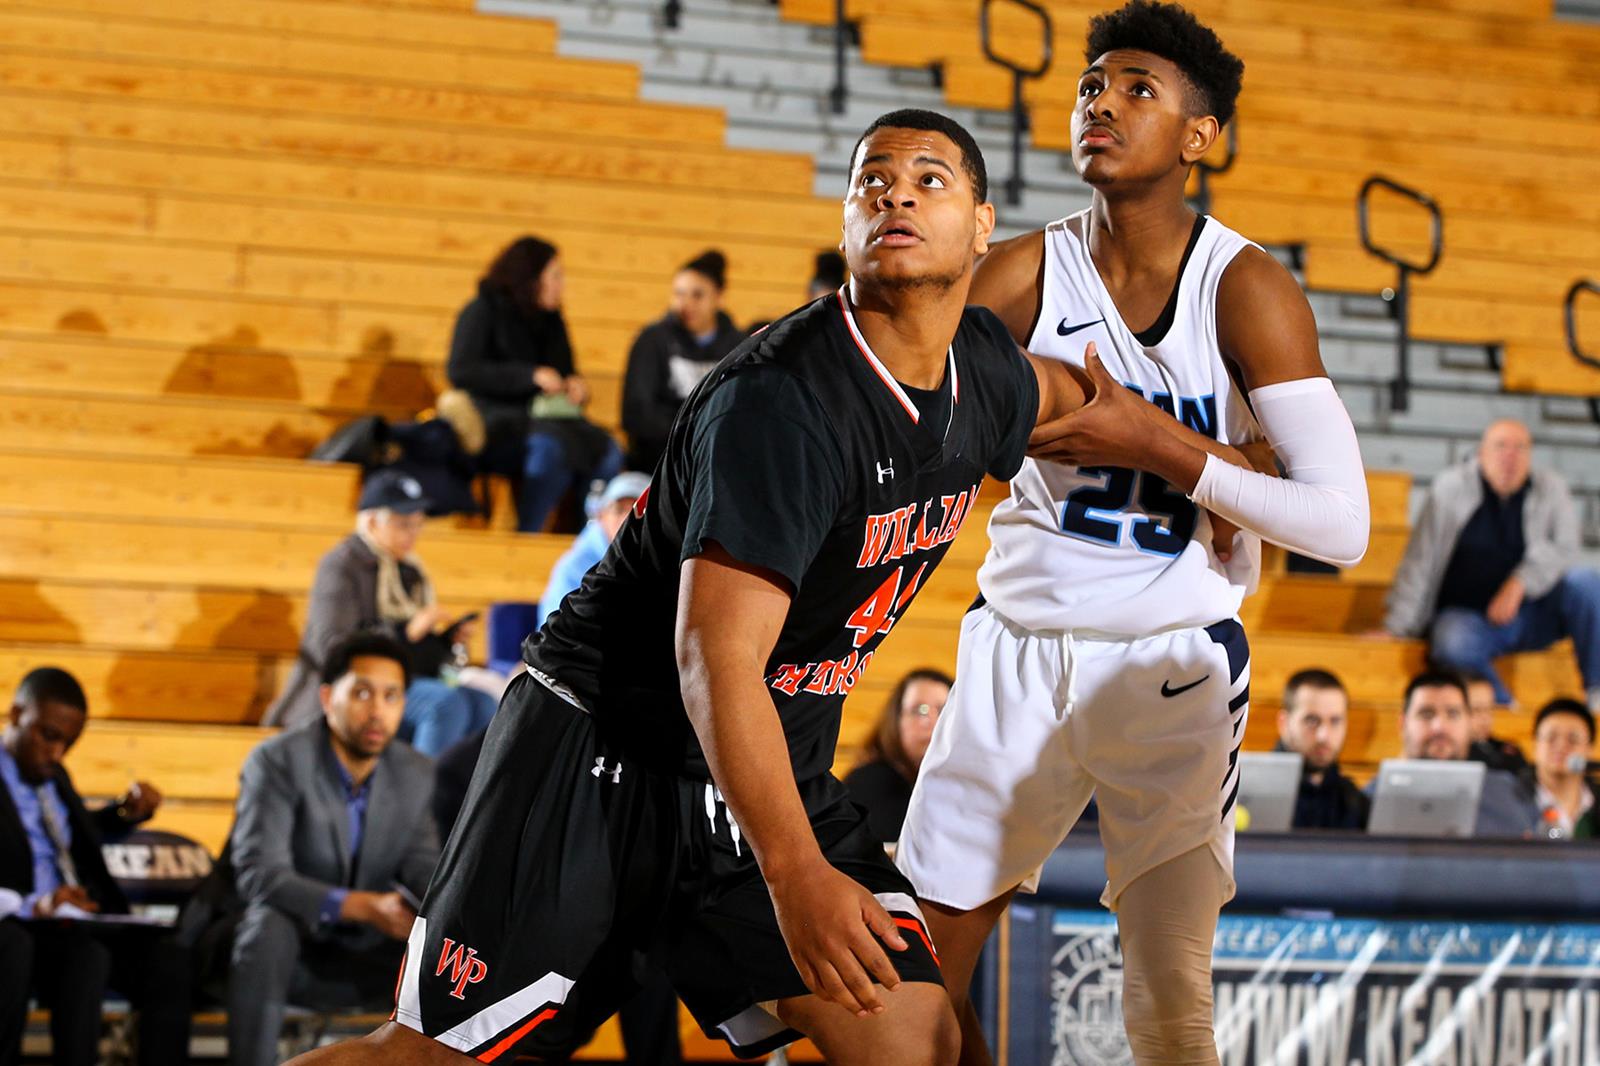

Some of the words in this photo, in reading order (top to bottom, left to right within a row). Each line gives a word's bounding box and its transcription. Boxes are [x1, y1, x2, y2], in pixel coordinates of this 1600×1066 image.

[1059, 465, 1198, 559] 25
[101, 843, 213, 880] KEAN
[435, 937, 488, 1000] WP
